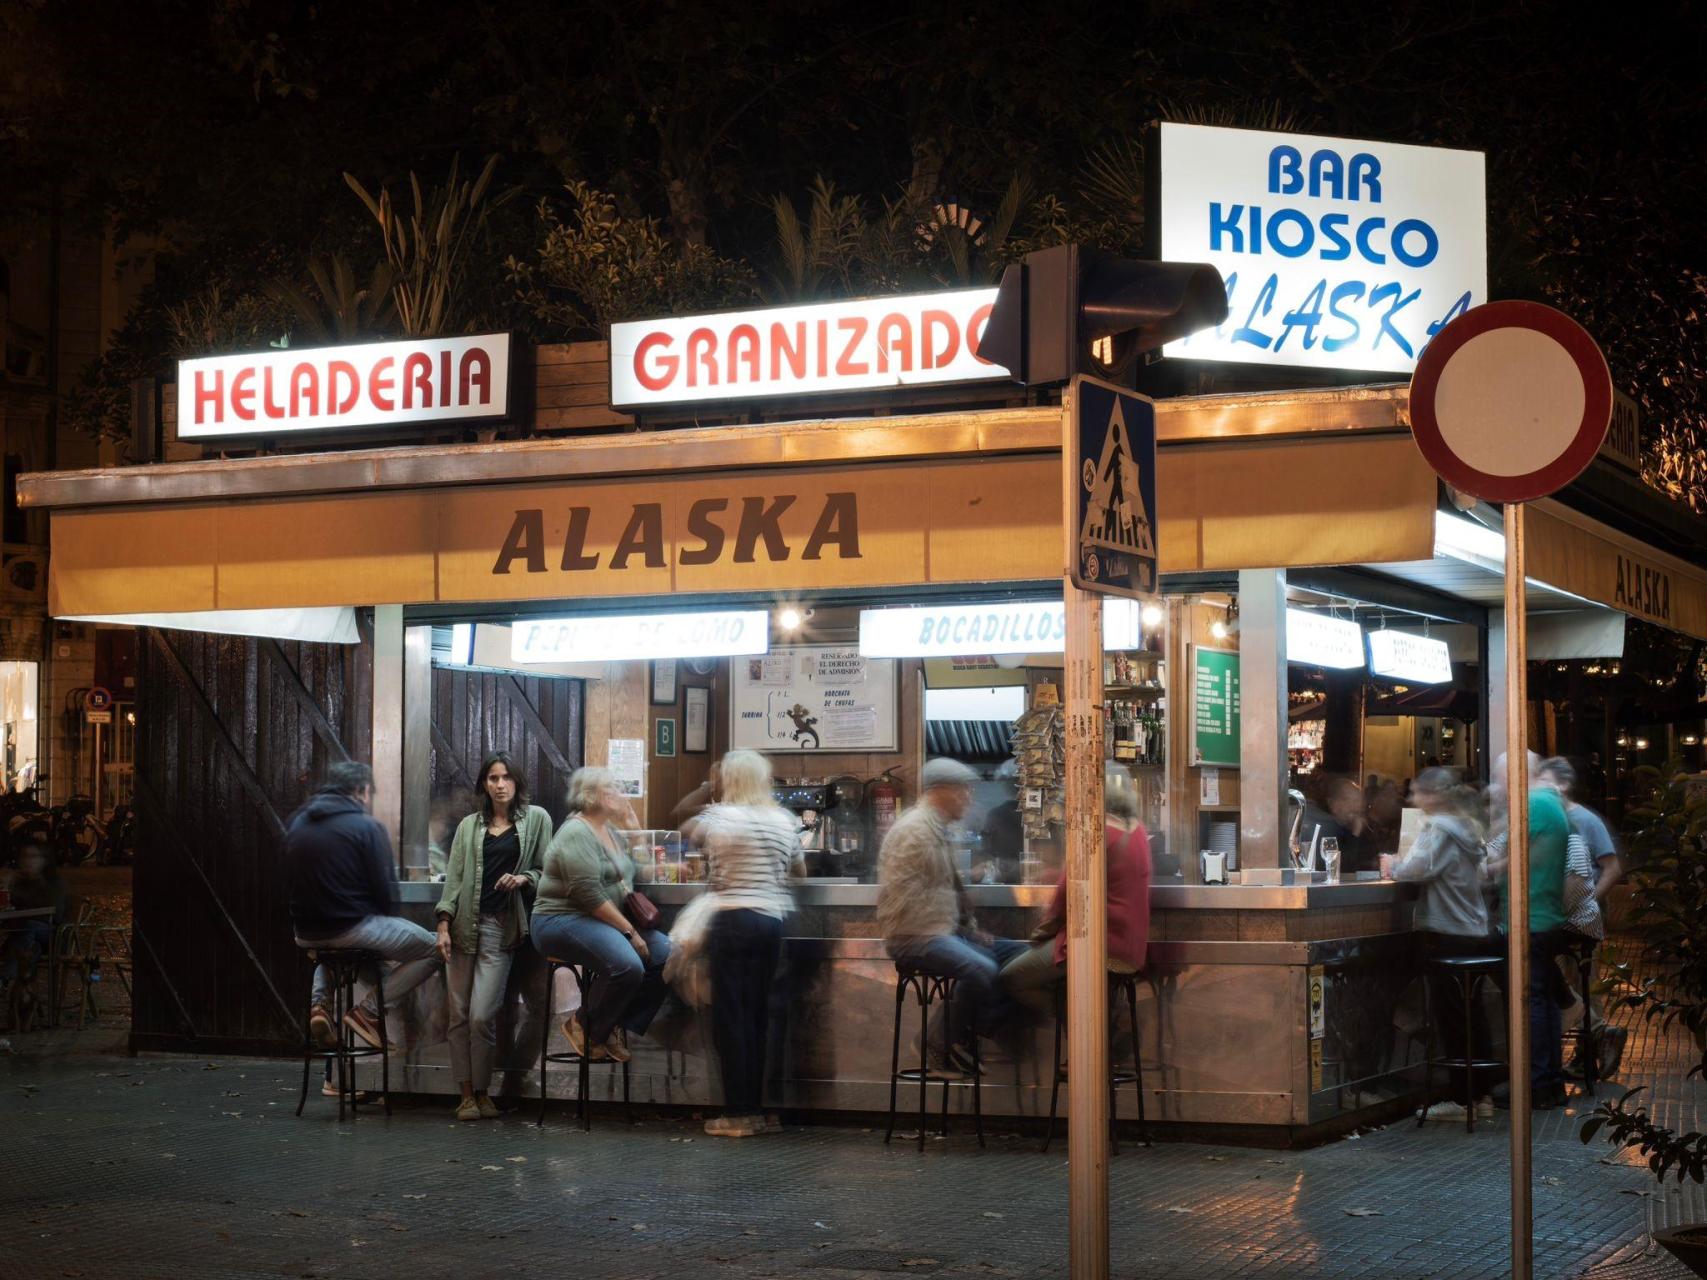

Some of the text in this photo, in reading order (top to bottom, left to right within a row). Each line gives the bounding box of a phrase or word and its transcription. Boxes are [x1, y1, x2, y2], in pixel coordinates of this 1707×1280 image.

[1267, 144, 1382, 203] BAR
[1209, 202, 1439, 268] KIOSCO
[194, 346, 492, 425] HELADERIA
[492, 491, 863, 575] ALASKA
[1615, 554, 1670, 621] ALASKA
[918, 610, 1065, 646] BOCADILLOS
[829, 660, 860, 668] DERECHO
[662, 725, 670, 744] B
